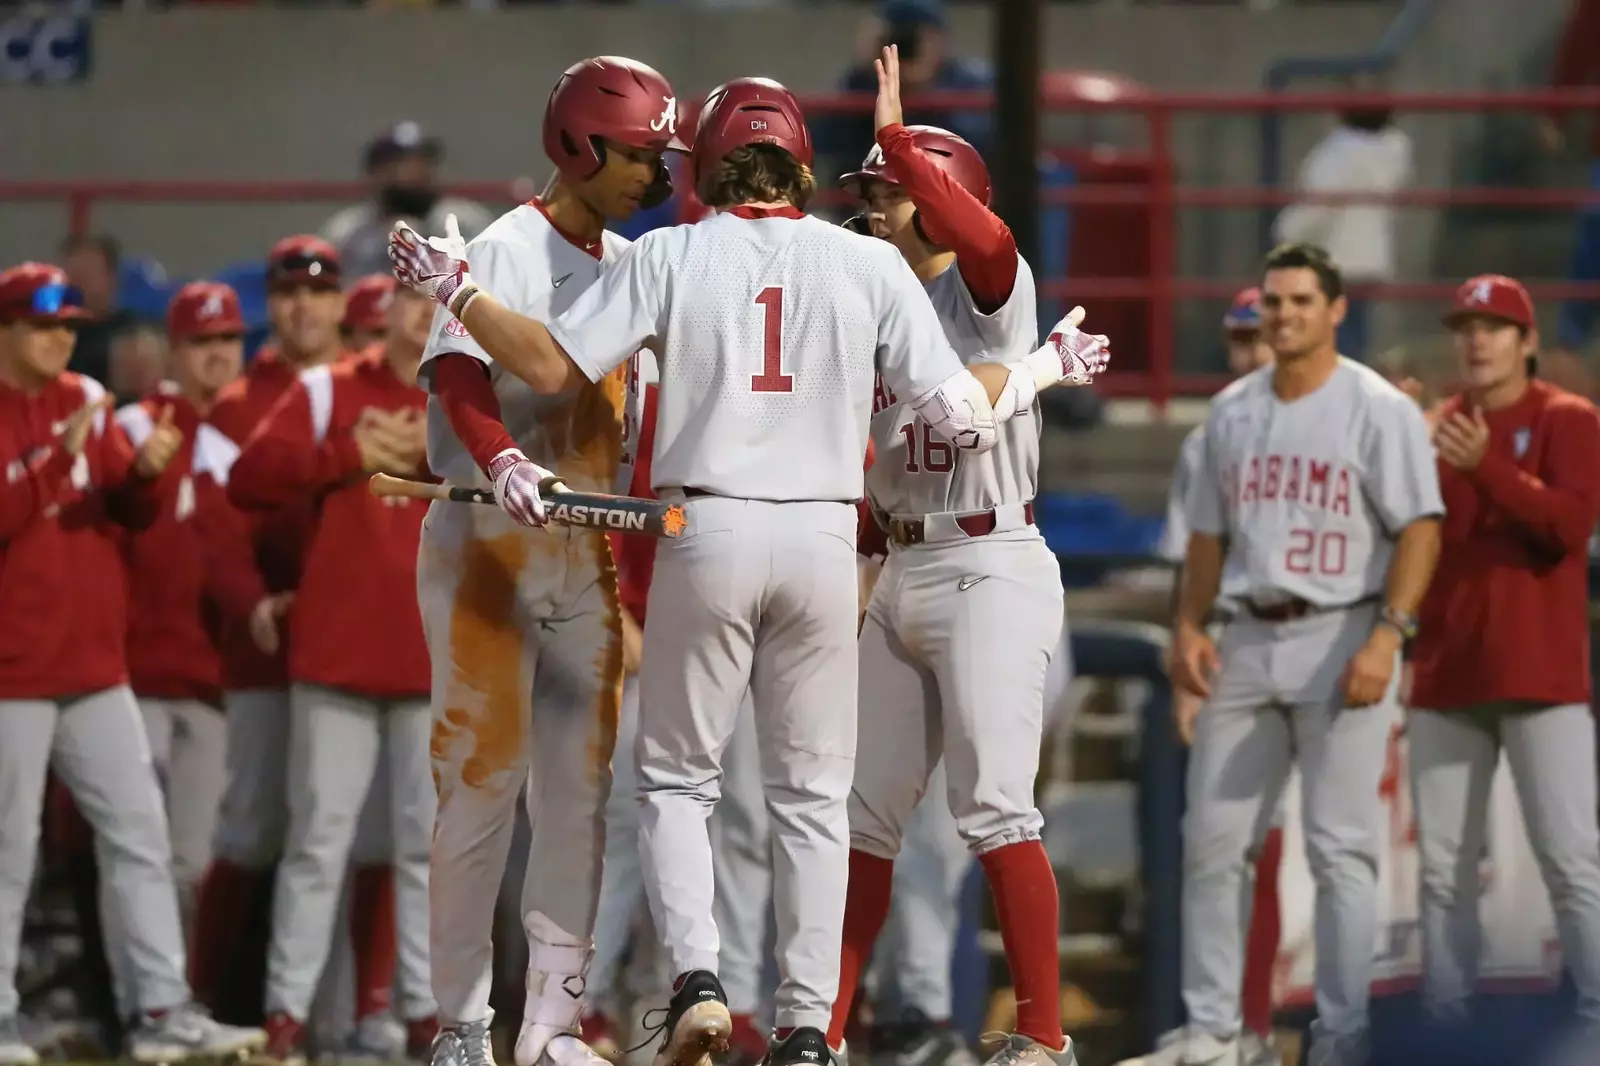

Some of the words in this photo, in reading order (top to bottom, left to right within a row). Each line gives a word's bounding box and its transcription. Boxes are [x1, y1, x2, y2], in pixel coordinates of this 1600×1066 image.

[649, 95, 677, 134] A
[750, 120, 767, 130] DH
[751, 286, 794, 393] 1
[899, 422, 955, 473] 16
[1222, 454, 1351, 516] ABAMA
[1285, 528, 1347, 575] 20
